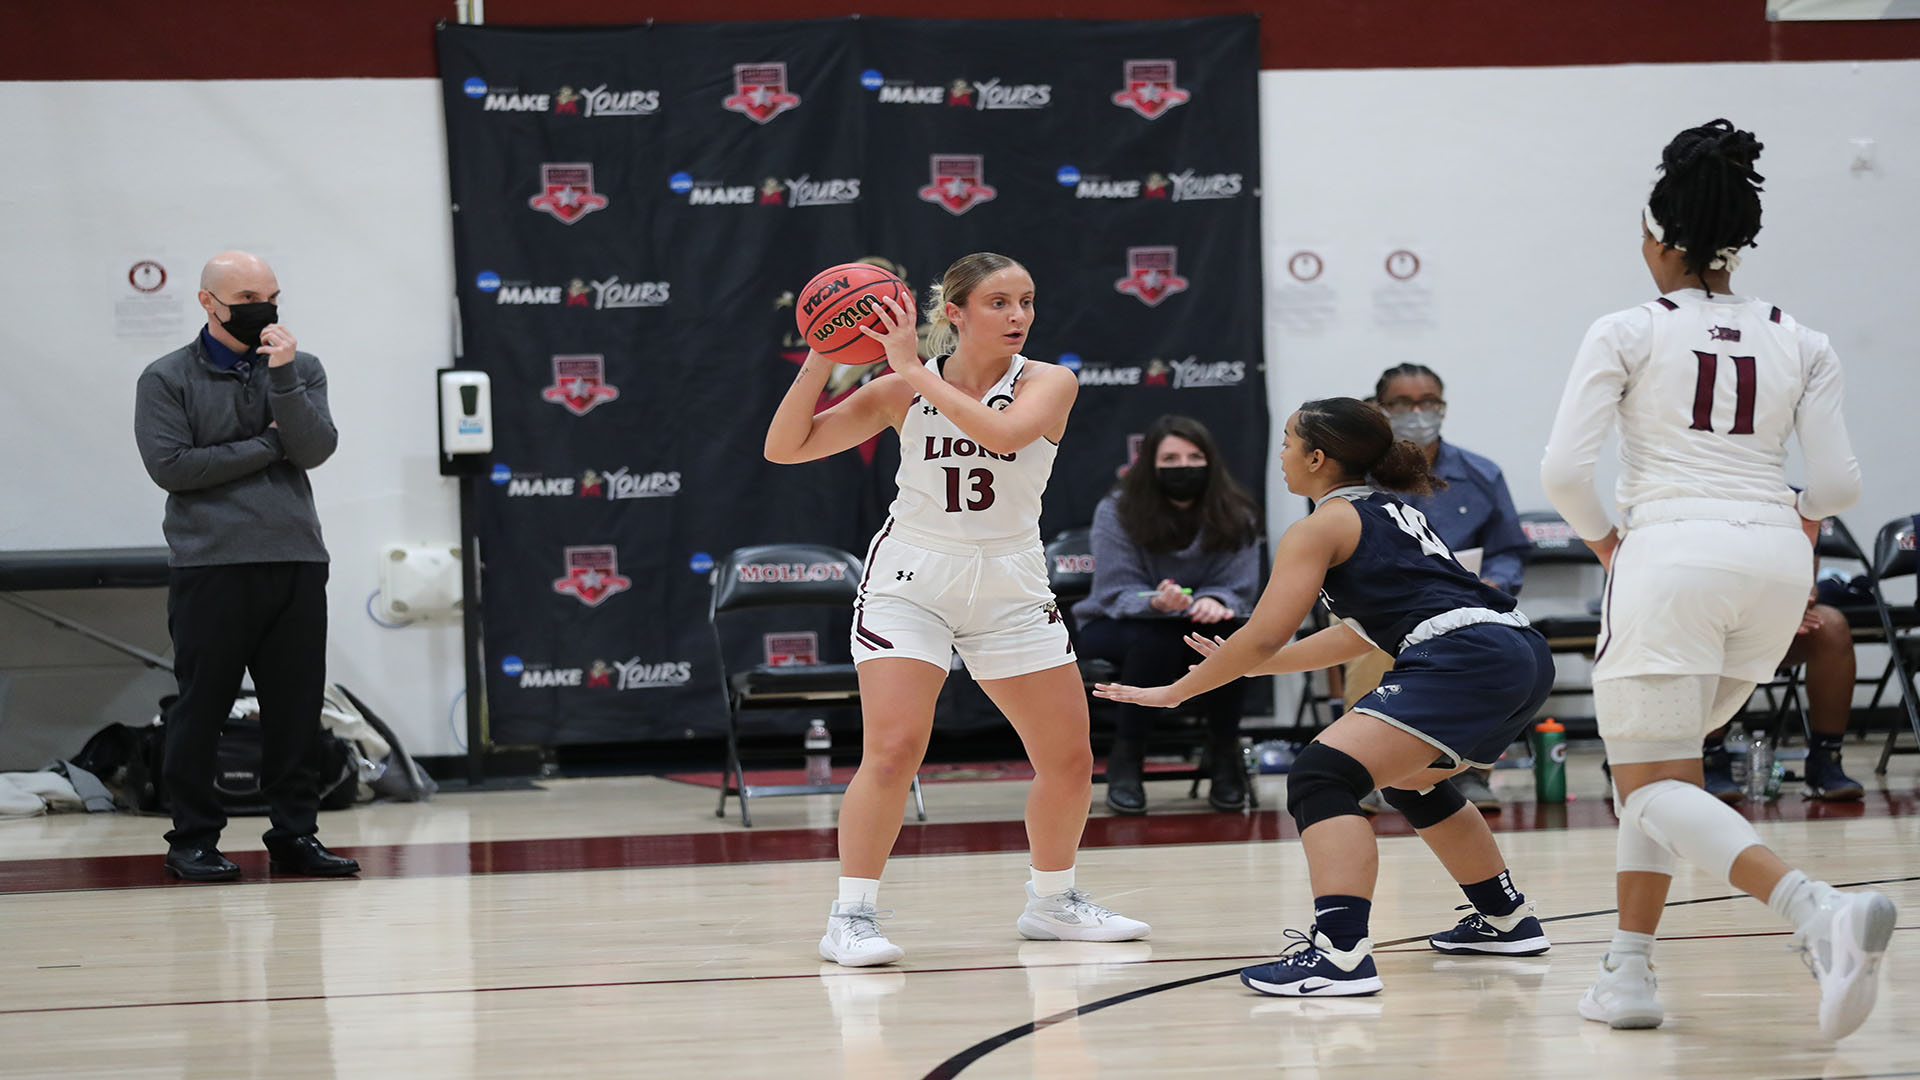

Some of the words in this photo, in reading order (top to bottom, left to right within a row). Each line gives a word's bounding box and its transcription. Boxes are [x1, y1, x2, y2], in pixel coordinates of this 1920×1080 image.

[484, 94, 551, 112] MAKE
[580, 83, 659, 117] YOURS
[878, 86, 945, 104] MAKE
[974, 78, 1051, 110] YOURS
[689, 186, 756, 206] MAKE
[785, 175, 860, 207] YOURS
[1075, 179, 1141, 199] MAKE
[1169, 169, 1242, 201] YOURS
[497, 286, 562, 305] MAKE
[591, 275, 670, 309] YOURS
[802, 276, 850, 316] NCAA
[813, 293, 885, 342] Wilson
[1078, 367, 1142, 387] MAKE
[1169, 356, 1245, 388] YOURS
[1688, 350, 1756, 434] 11
[507, 477, 575, 497] MAKE
[603, 466, 680, 500] YOURS
[941, 467, 996, 512] 13
[737, 563, 848, 583] MOLLOY
[520, 668, 583, 689] MAKE
[614, 656, 691, 690] YOURS
